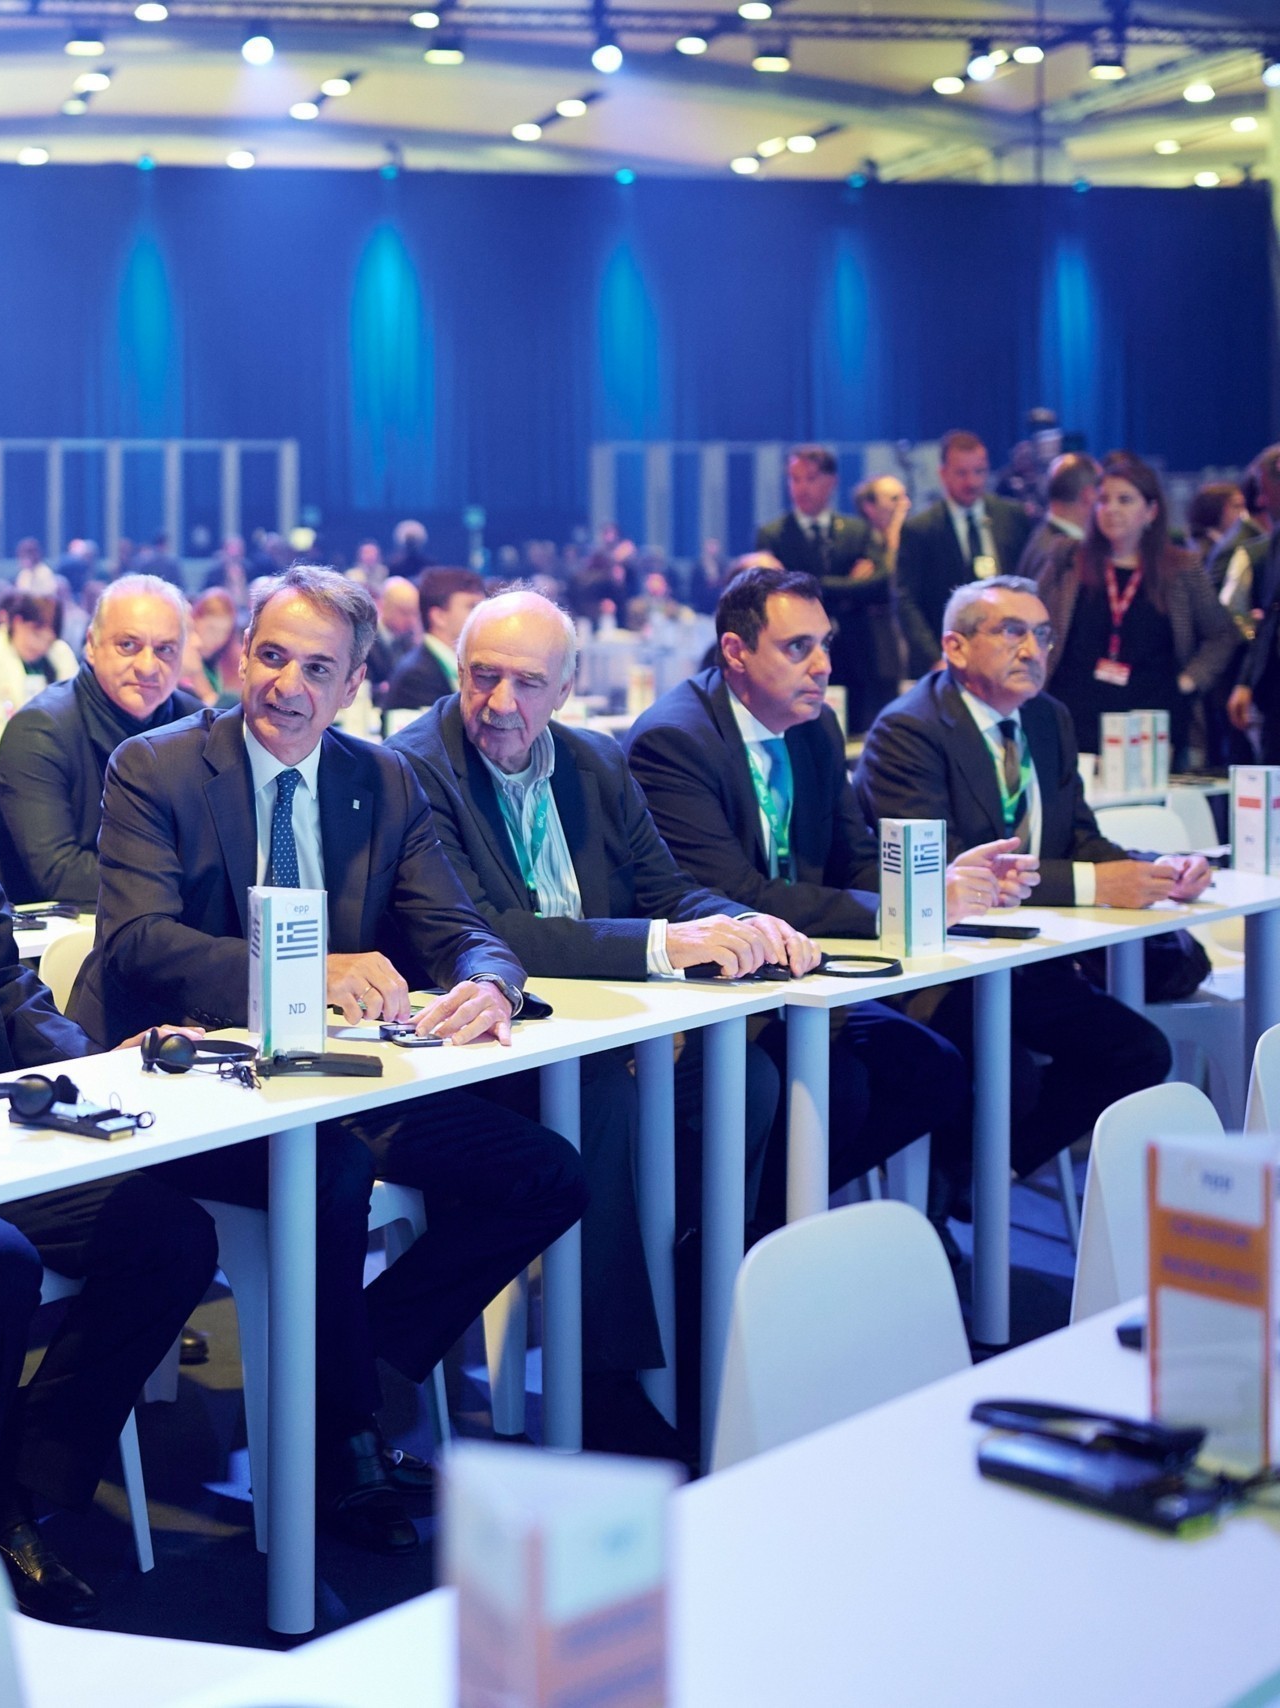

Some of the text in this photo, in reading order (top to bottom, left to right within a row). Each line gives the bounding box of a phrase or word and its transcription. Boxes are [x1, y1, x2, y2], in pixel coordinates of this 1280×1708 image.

[293, 903, 310, 915] epp
[921, 907, 934, 918] ND
[288, 1002, 307, 1015] ND
